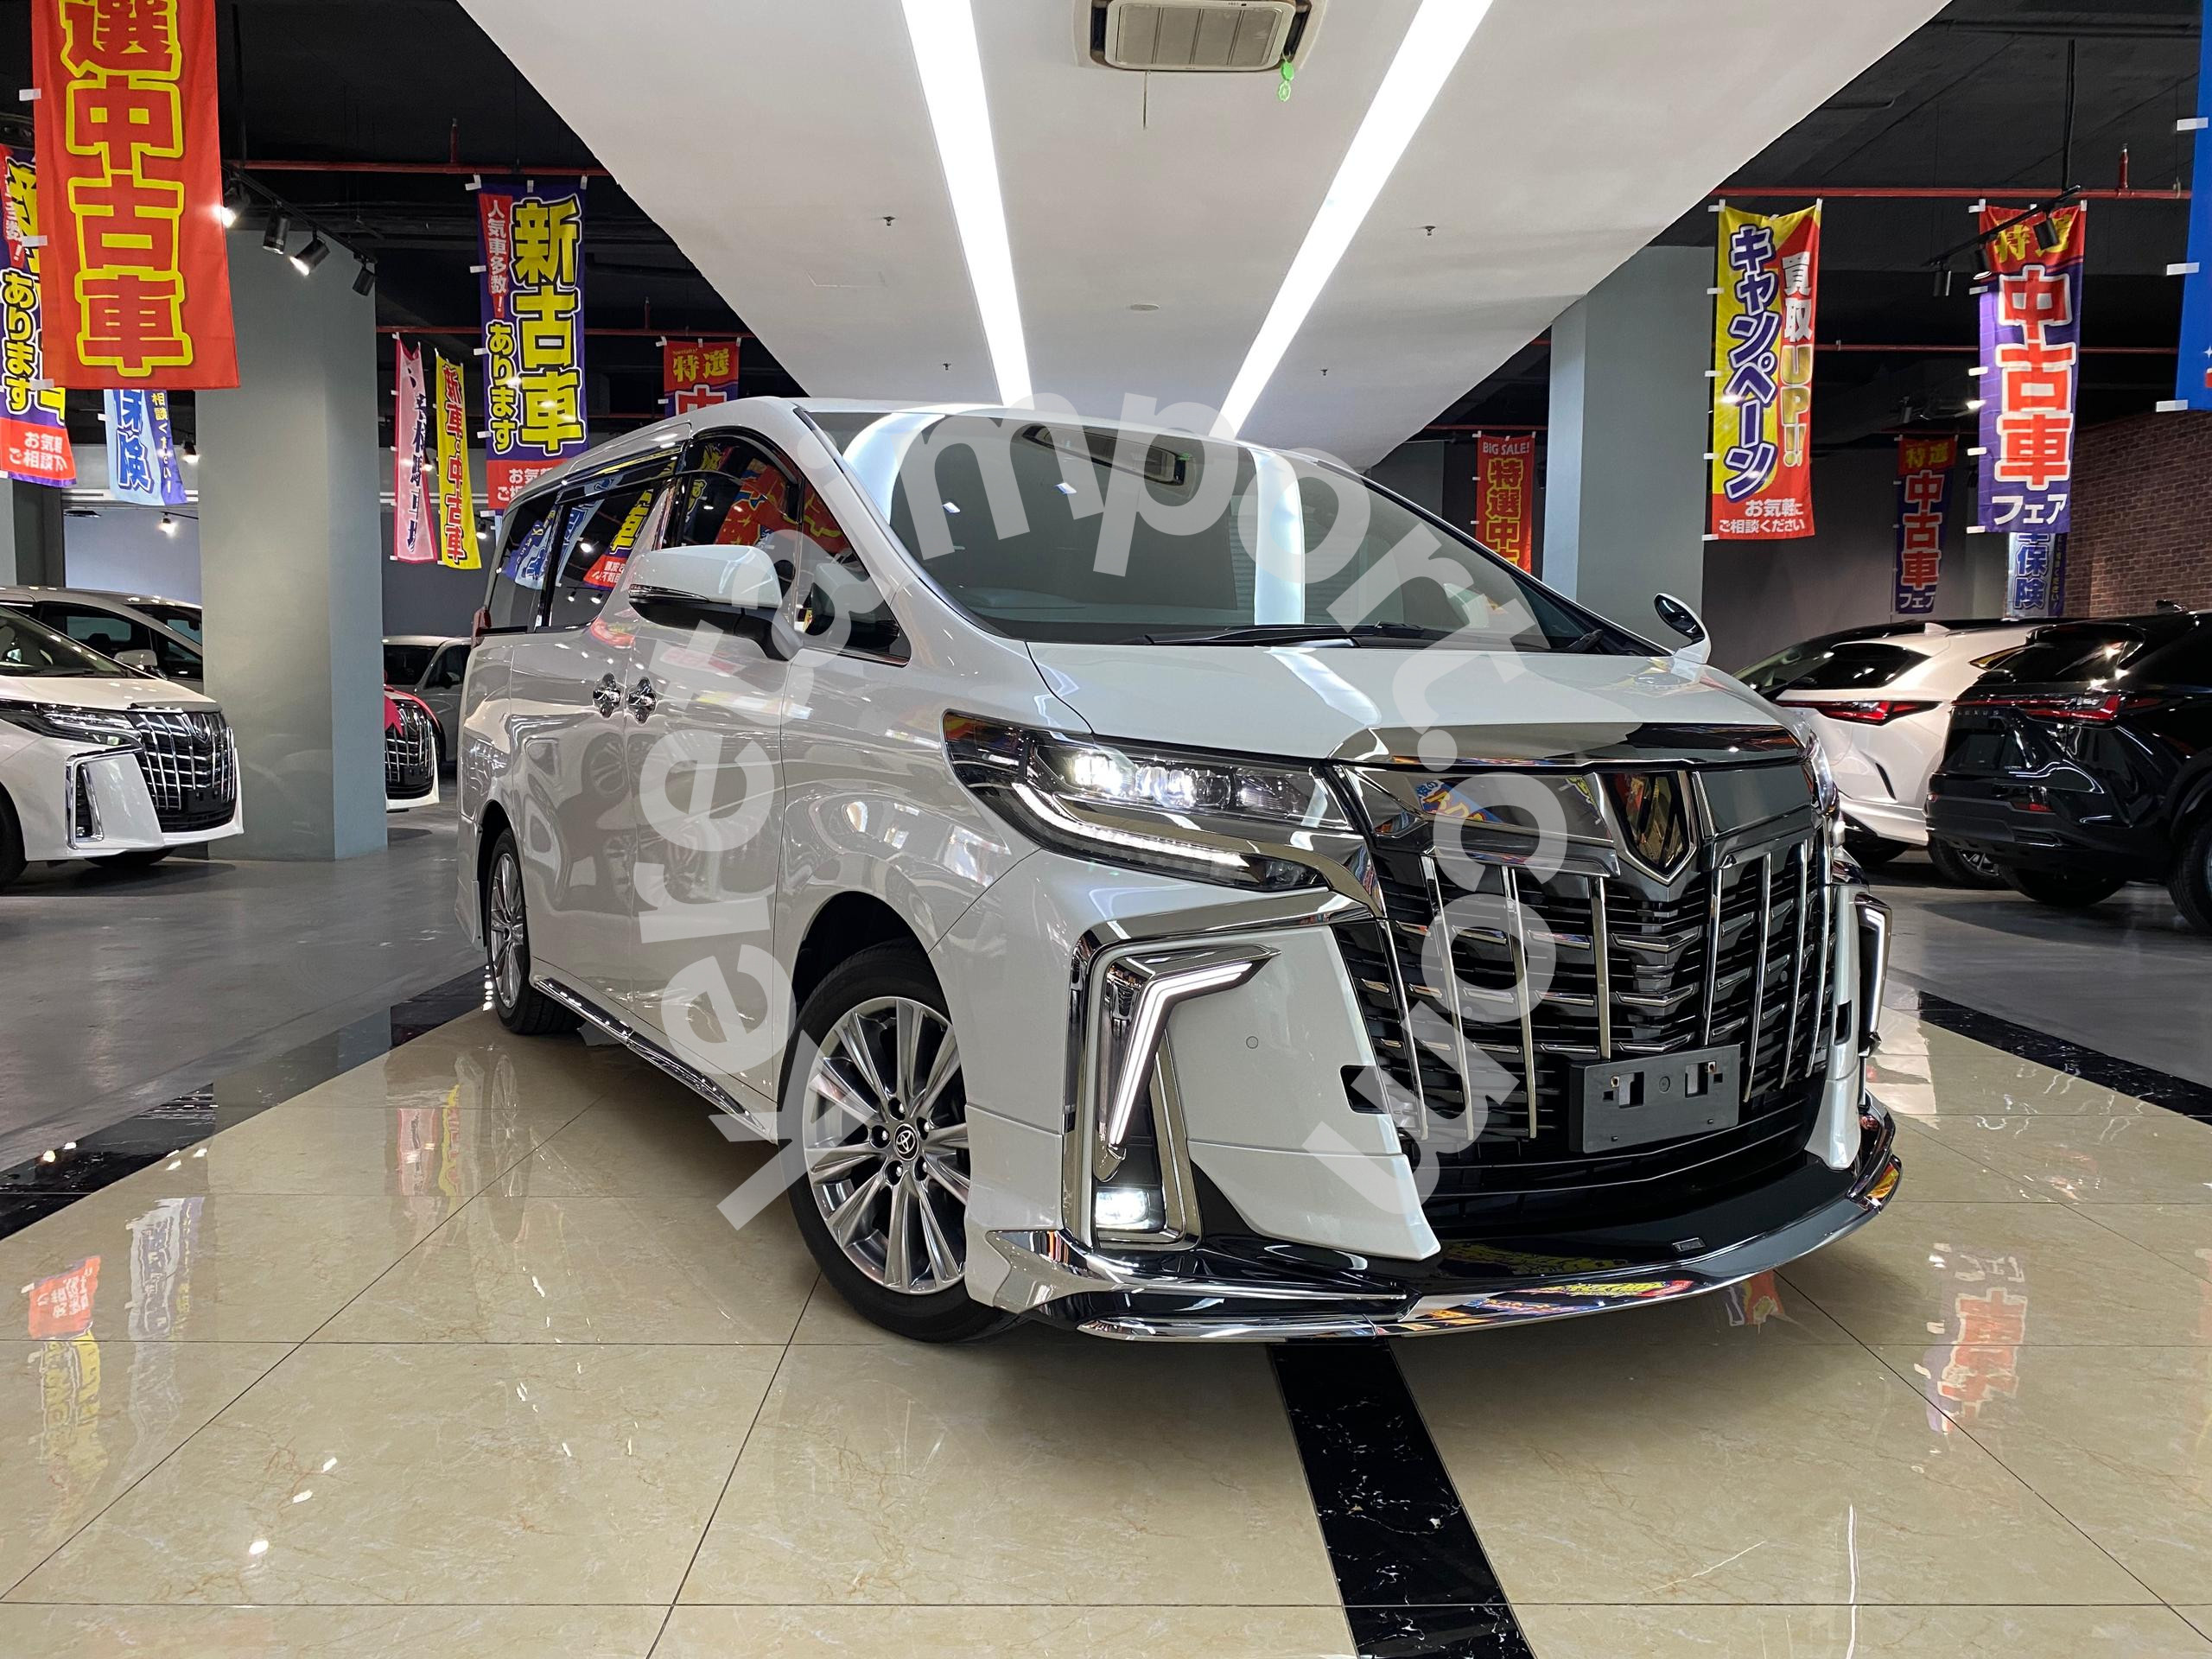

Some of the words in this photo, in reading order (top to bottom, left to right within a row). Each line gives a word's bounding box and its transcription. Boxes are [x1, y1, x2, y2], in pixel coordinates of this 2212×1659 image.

[0, 268, 41, 416] あります
[510, 194, 587, 457] 新古車
[672, 348, 730, 382] 特選
[1723, 224, 1780, 503] キャンペーン
[1996, 264, 2076, 491] 中古車
[485, 319, 519, 454] あります
[1501, 442, 1530, 455] SALE!
[1745, 498, 1804, 518] お気軽に
[1990, 493, 2069, 525] フェア
[1718, 518, 1806, 534] ご相談ください
[1902, 469, 1945, 590] 中古車
